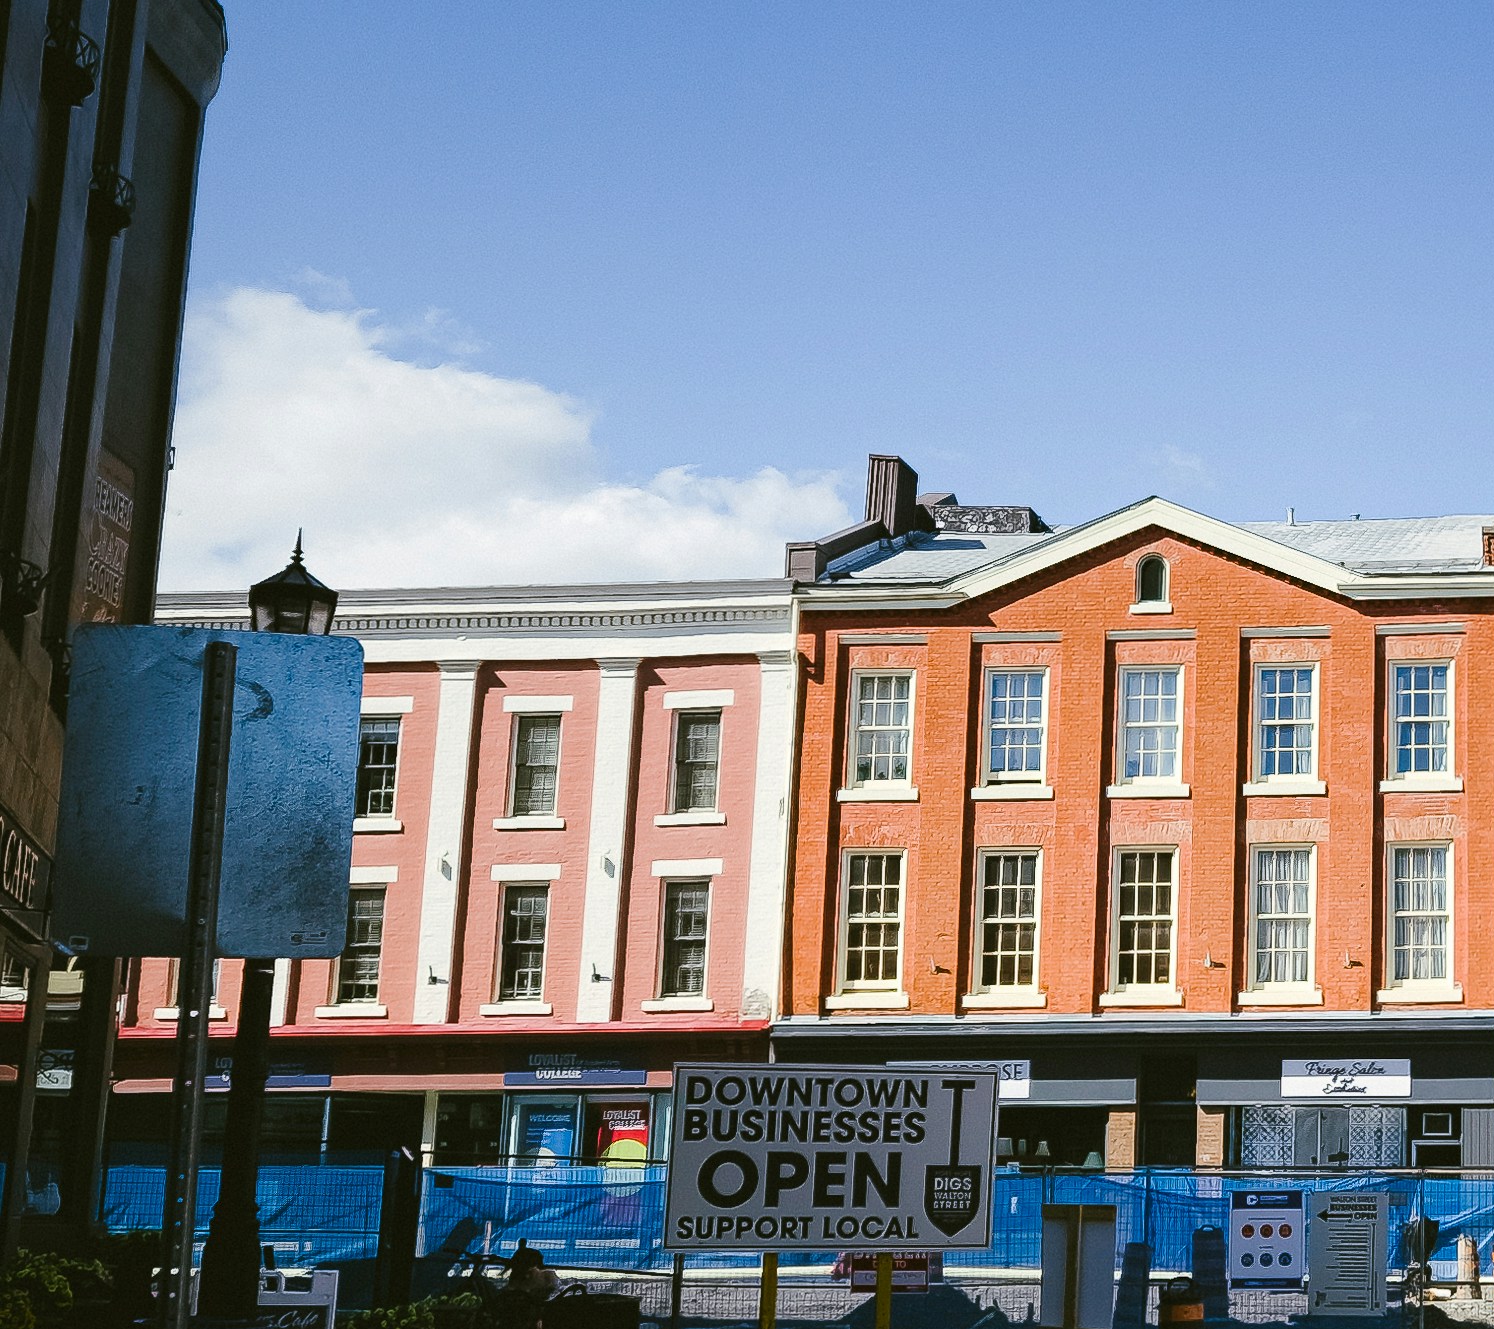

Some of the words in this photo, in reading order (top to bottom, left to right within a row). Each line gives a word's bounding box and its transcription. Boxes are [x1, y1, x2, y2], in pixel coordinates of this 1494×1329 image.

[528, 1054, 577, 1066] LOYALIST
[535, 1067, 583, 1080] COLLEGE
[1348, 1061, 1386, 1076] Salon
[684, 1075, 929, 1109] DOWNTOWN
[529, 1114, 571, 1122] WELCOME
[603, 1110, 642, 1120] LOYALIST
[682, 1109, 928, 1145] BUSINESSES
[696, 1149, 903, 1209] OPEN
[934, 1177, 972, 1191] DIGS
[933, 1192, 972, 1200] WALTON
[933, 1201, 971, 1209] STREET
[676, 1215, 814, 1241] SUPPORT
[822, 1215, 920, 1240] LOCAL
